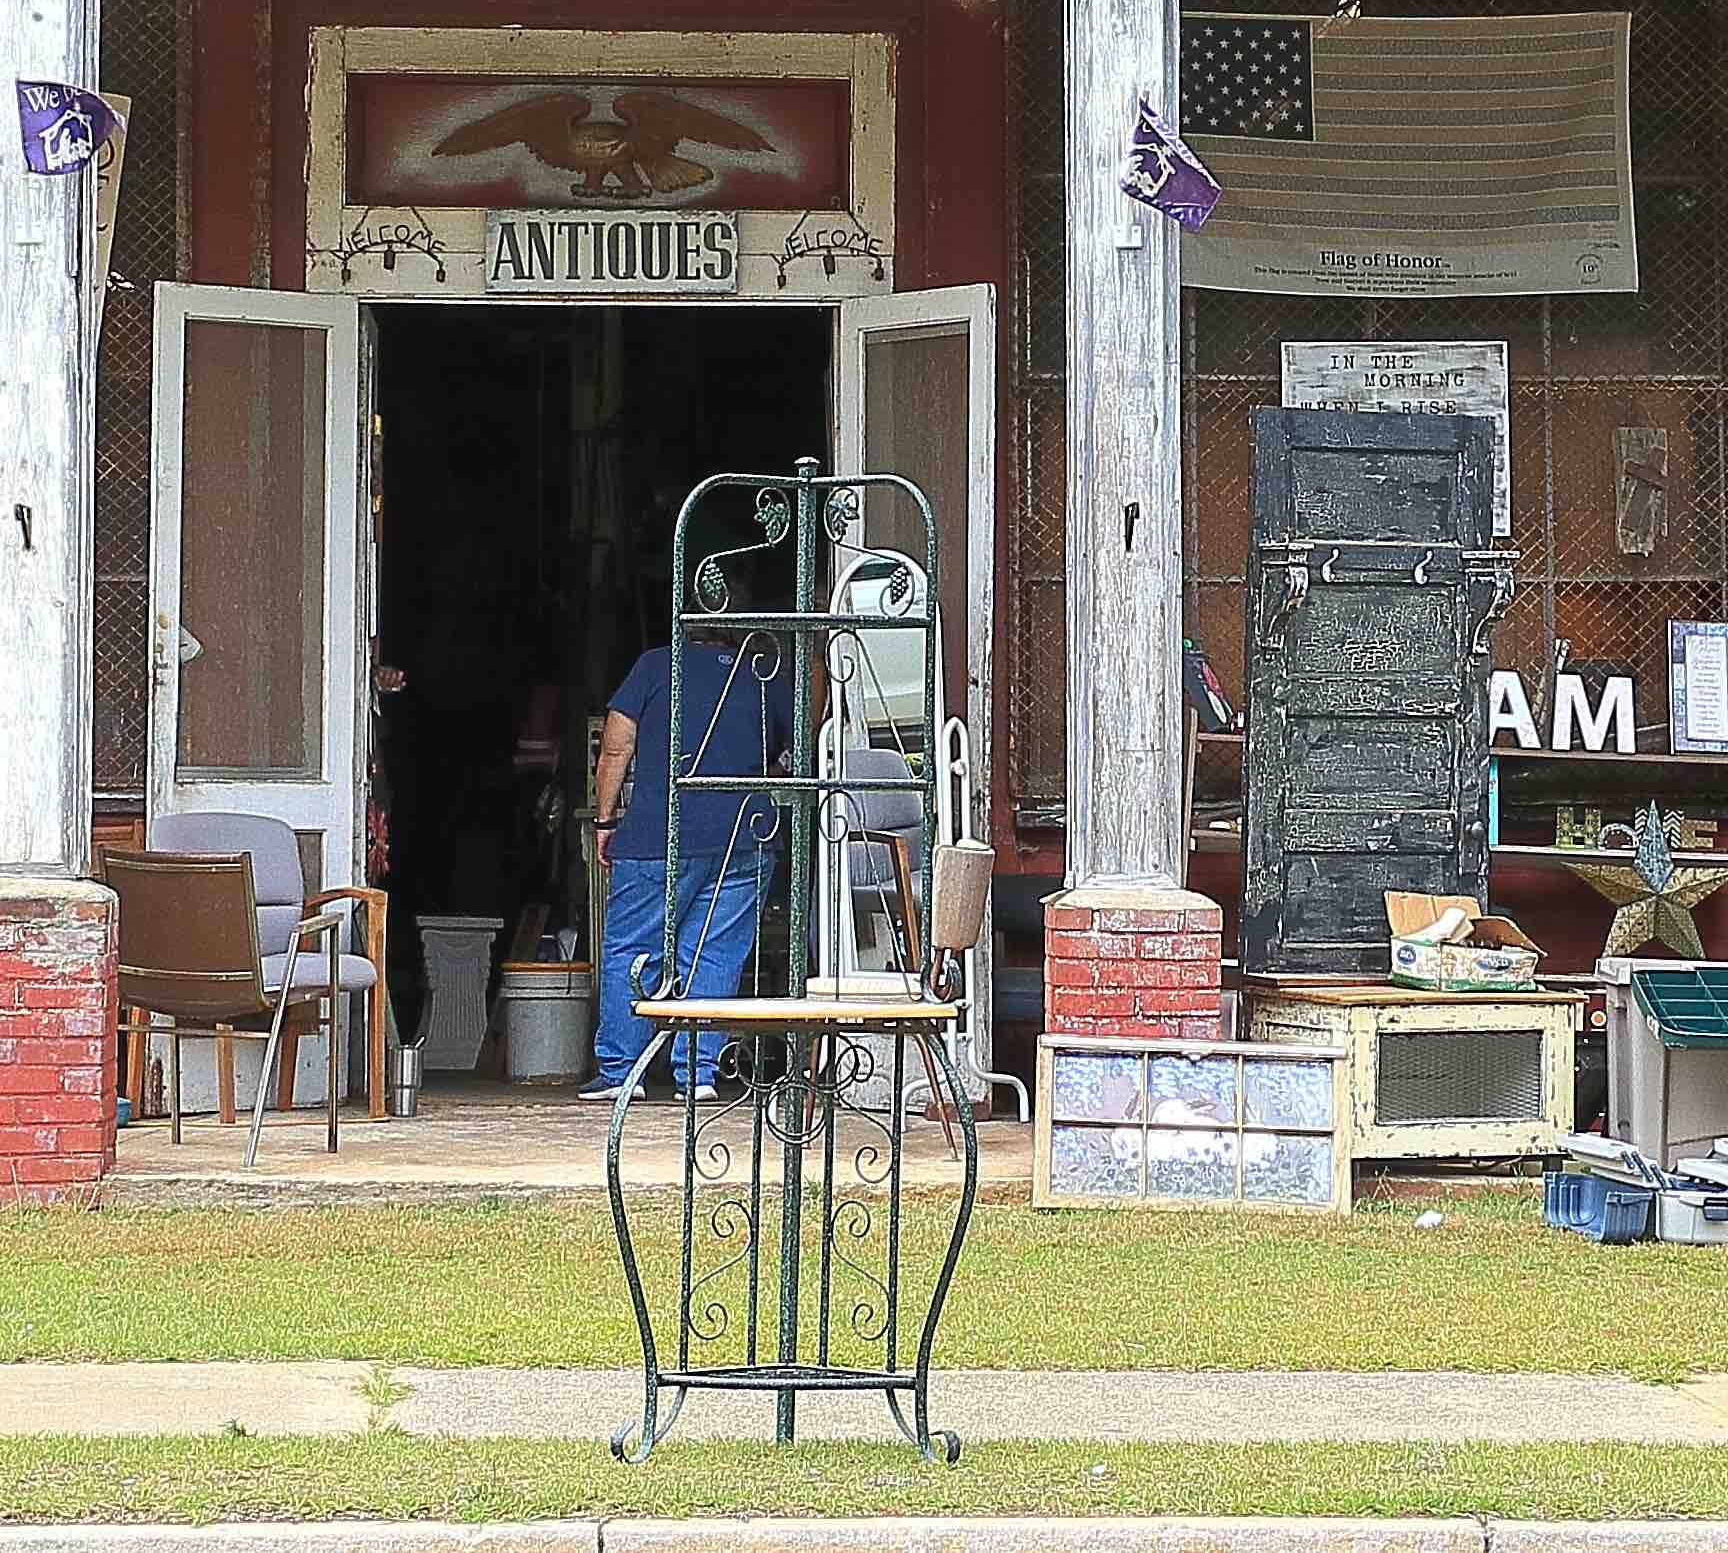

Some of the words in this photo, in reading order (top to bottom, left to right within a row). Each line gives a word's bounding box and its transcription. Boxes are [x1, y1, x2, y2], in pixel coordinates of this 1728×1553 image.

[24, 86, 61, 113] We
[329, 225, 447, 261] WELCOME
[490, 221, 734, 281] ANTIQUES
[770, 229, 884, 266] WELCOME
[1320, 250, 1356, 270] Flag
[1362, 252, 1381, 267] of
[1386, 253, 1442, 268] Honor
[1330, 355, 1355, 369] IN
[1372, 355, 1414, 369] THE
[1364, 373, 1466, 388] MORNING
[1400, 400, 1457, 414] RISE
[1489, 670, 1636, 754] AM
